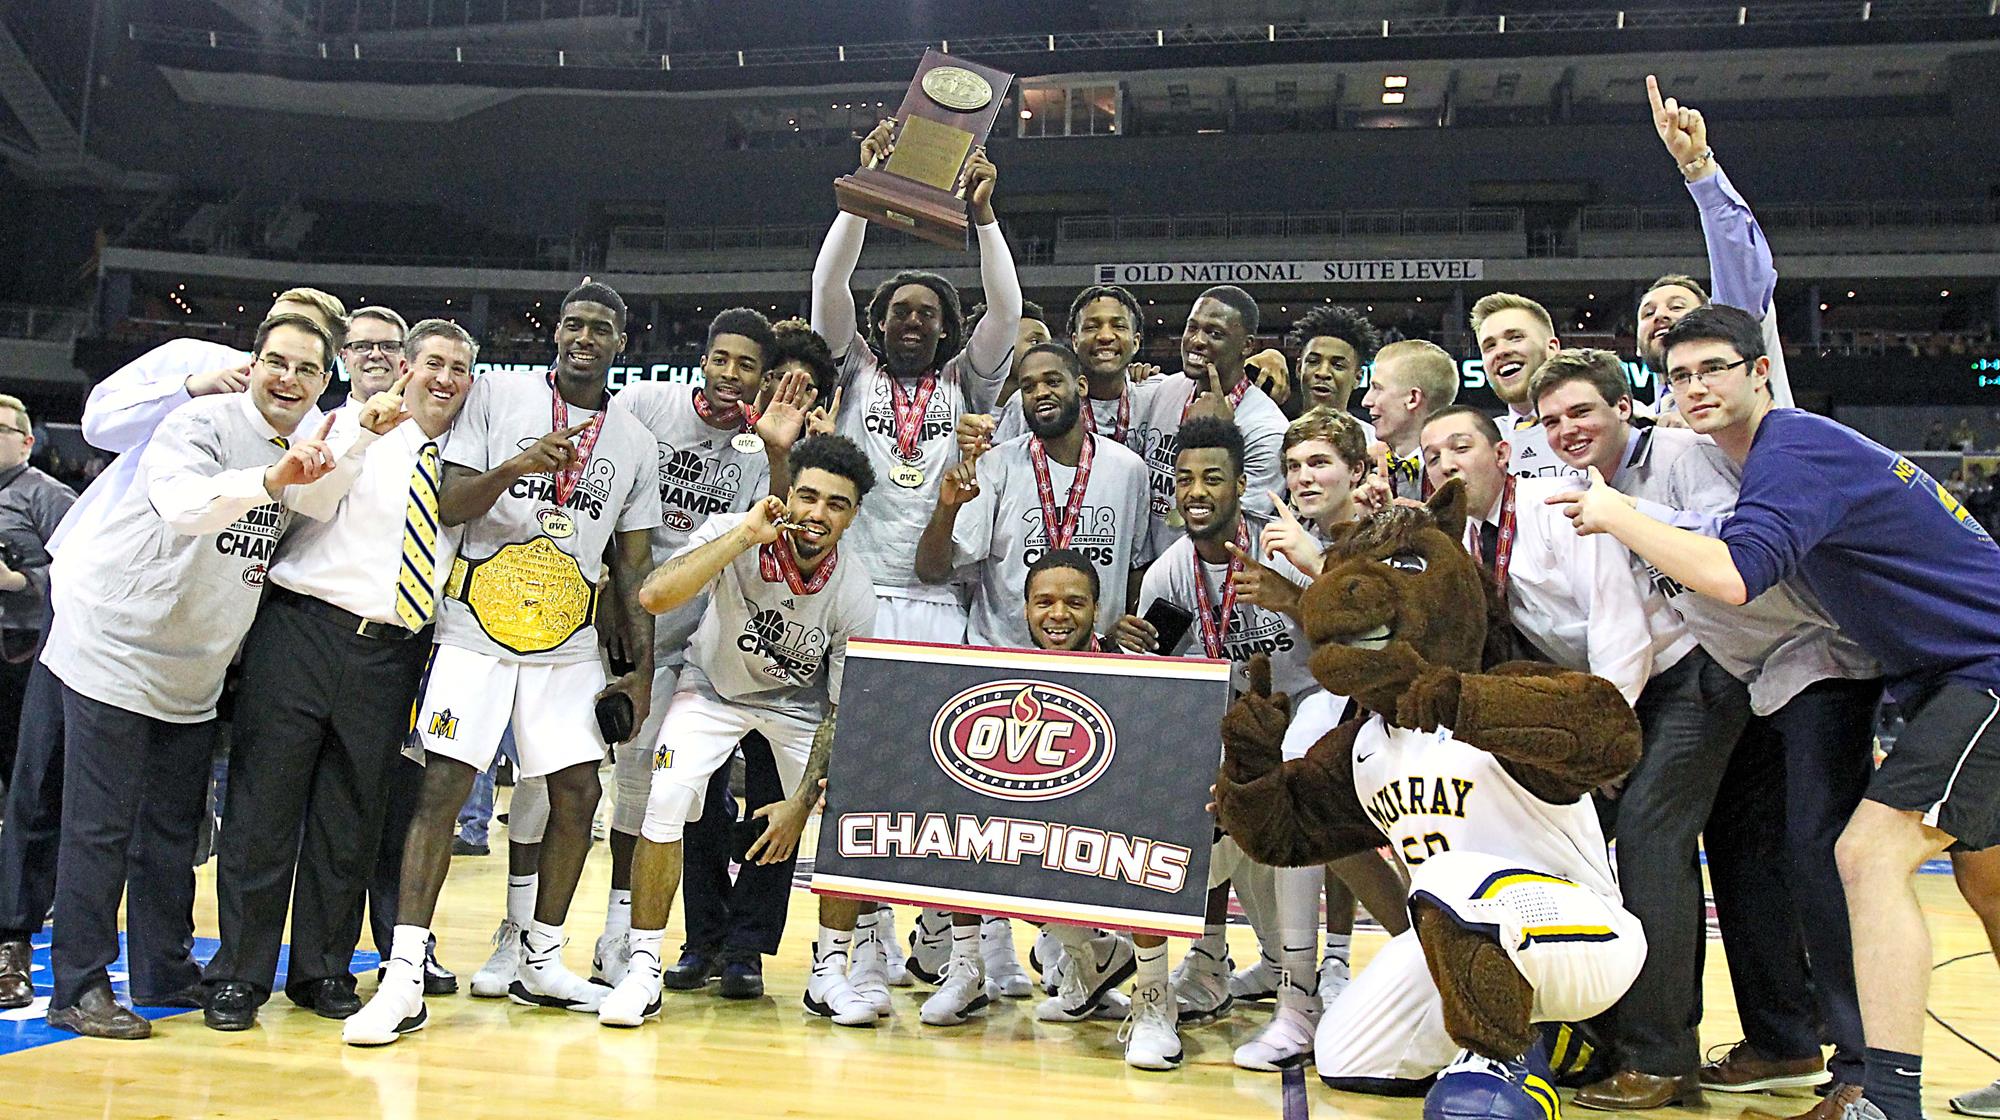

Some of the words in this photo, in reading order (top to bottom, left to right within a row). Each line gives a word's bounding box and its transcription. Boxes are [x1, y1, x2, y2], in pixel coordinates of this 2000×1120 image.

[1124, 265, 1174, 282] OLD
[1180, 264, 1302, 282] NATIONAL
[1324, 263, 1395, 281] SUITE
[1401, 262, 1477, 279] LEVEL
[900, 473, 917, 482] OVC
[1152, 501, 1168, 514] OVC
[548, 522, 568, 532] OVC
[667, 514, 688, 528] OVC
[955, 692, 1003, 716] OHIO
[1042, 693, 1103, 735] VALLEY
[966, 715, 1076, 767] OVC
[953, 760, 1082, 790] CONFERENCE
[838, 811, 1191, 894] CHAMPIONS
